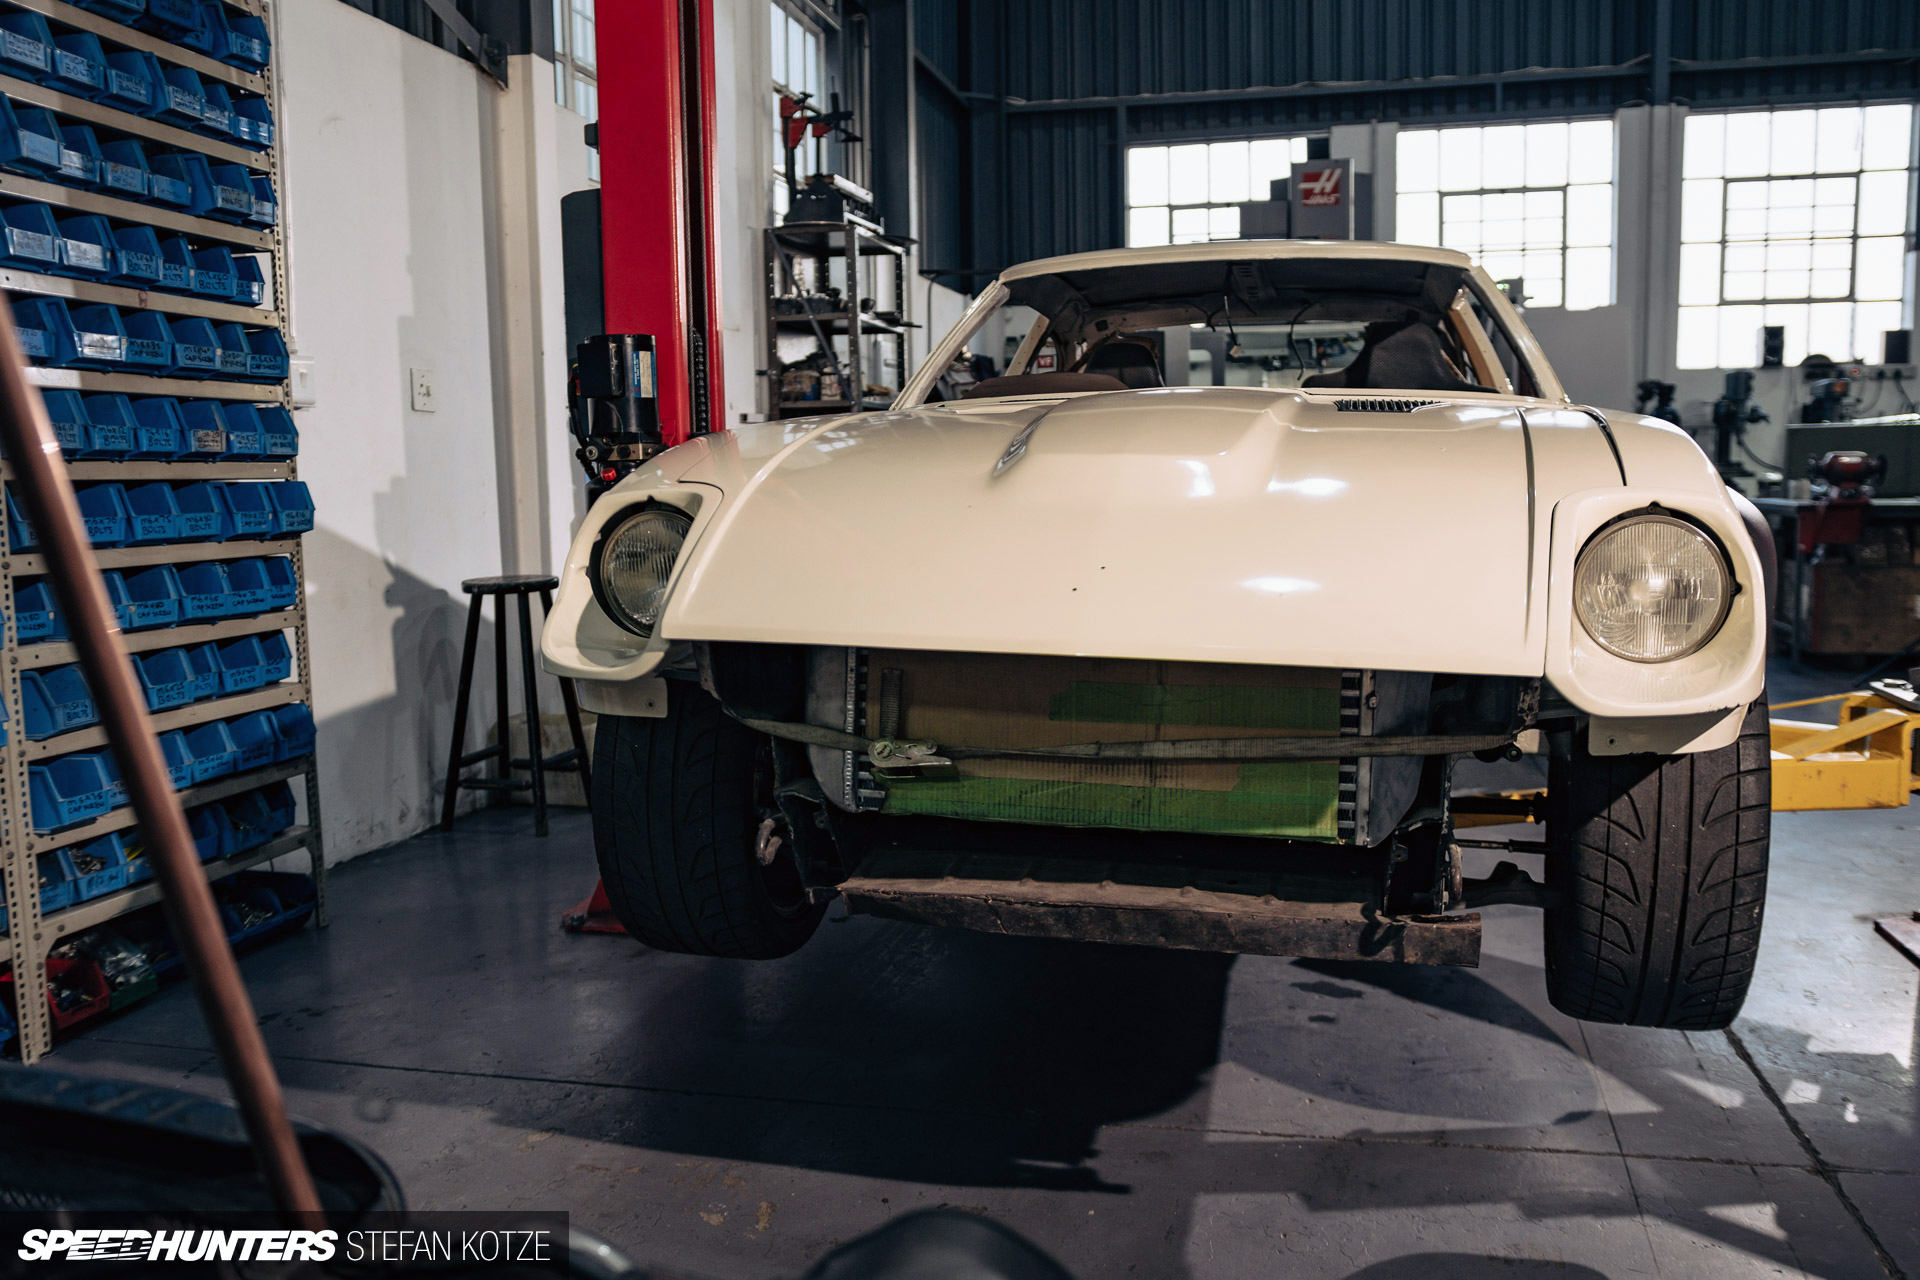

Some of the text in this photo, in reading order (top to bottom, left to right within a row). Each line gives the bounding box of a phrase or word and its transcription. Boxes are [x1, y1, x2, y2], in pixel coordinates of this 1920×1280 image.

[127, 260, 154, 274] BOLTS
[162, 272, 184, 282] OLTS
[198, 279, 228, 291] BOLTS
[57, 432, 77, 443] OLTS
[103, 434, 128, 446] BOLTS
[148, 435, 172, 447] BOLTS
[87, 526, 113, 537] BOLTS
[141, 525, 166, 536] BOLTS
[189, 523, 211, 533] BOLTS
[232, 597, 245, 607] CAP
[191, 603, 205, 613] CAP
[137, 609, 150, 619] CAP
[233, 675, 256, 687] BOLTS
[158, 692, 185, 705] BOLTS
[67, 805, 82, 814] CAP
